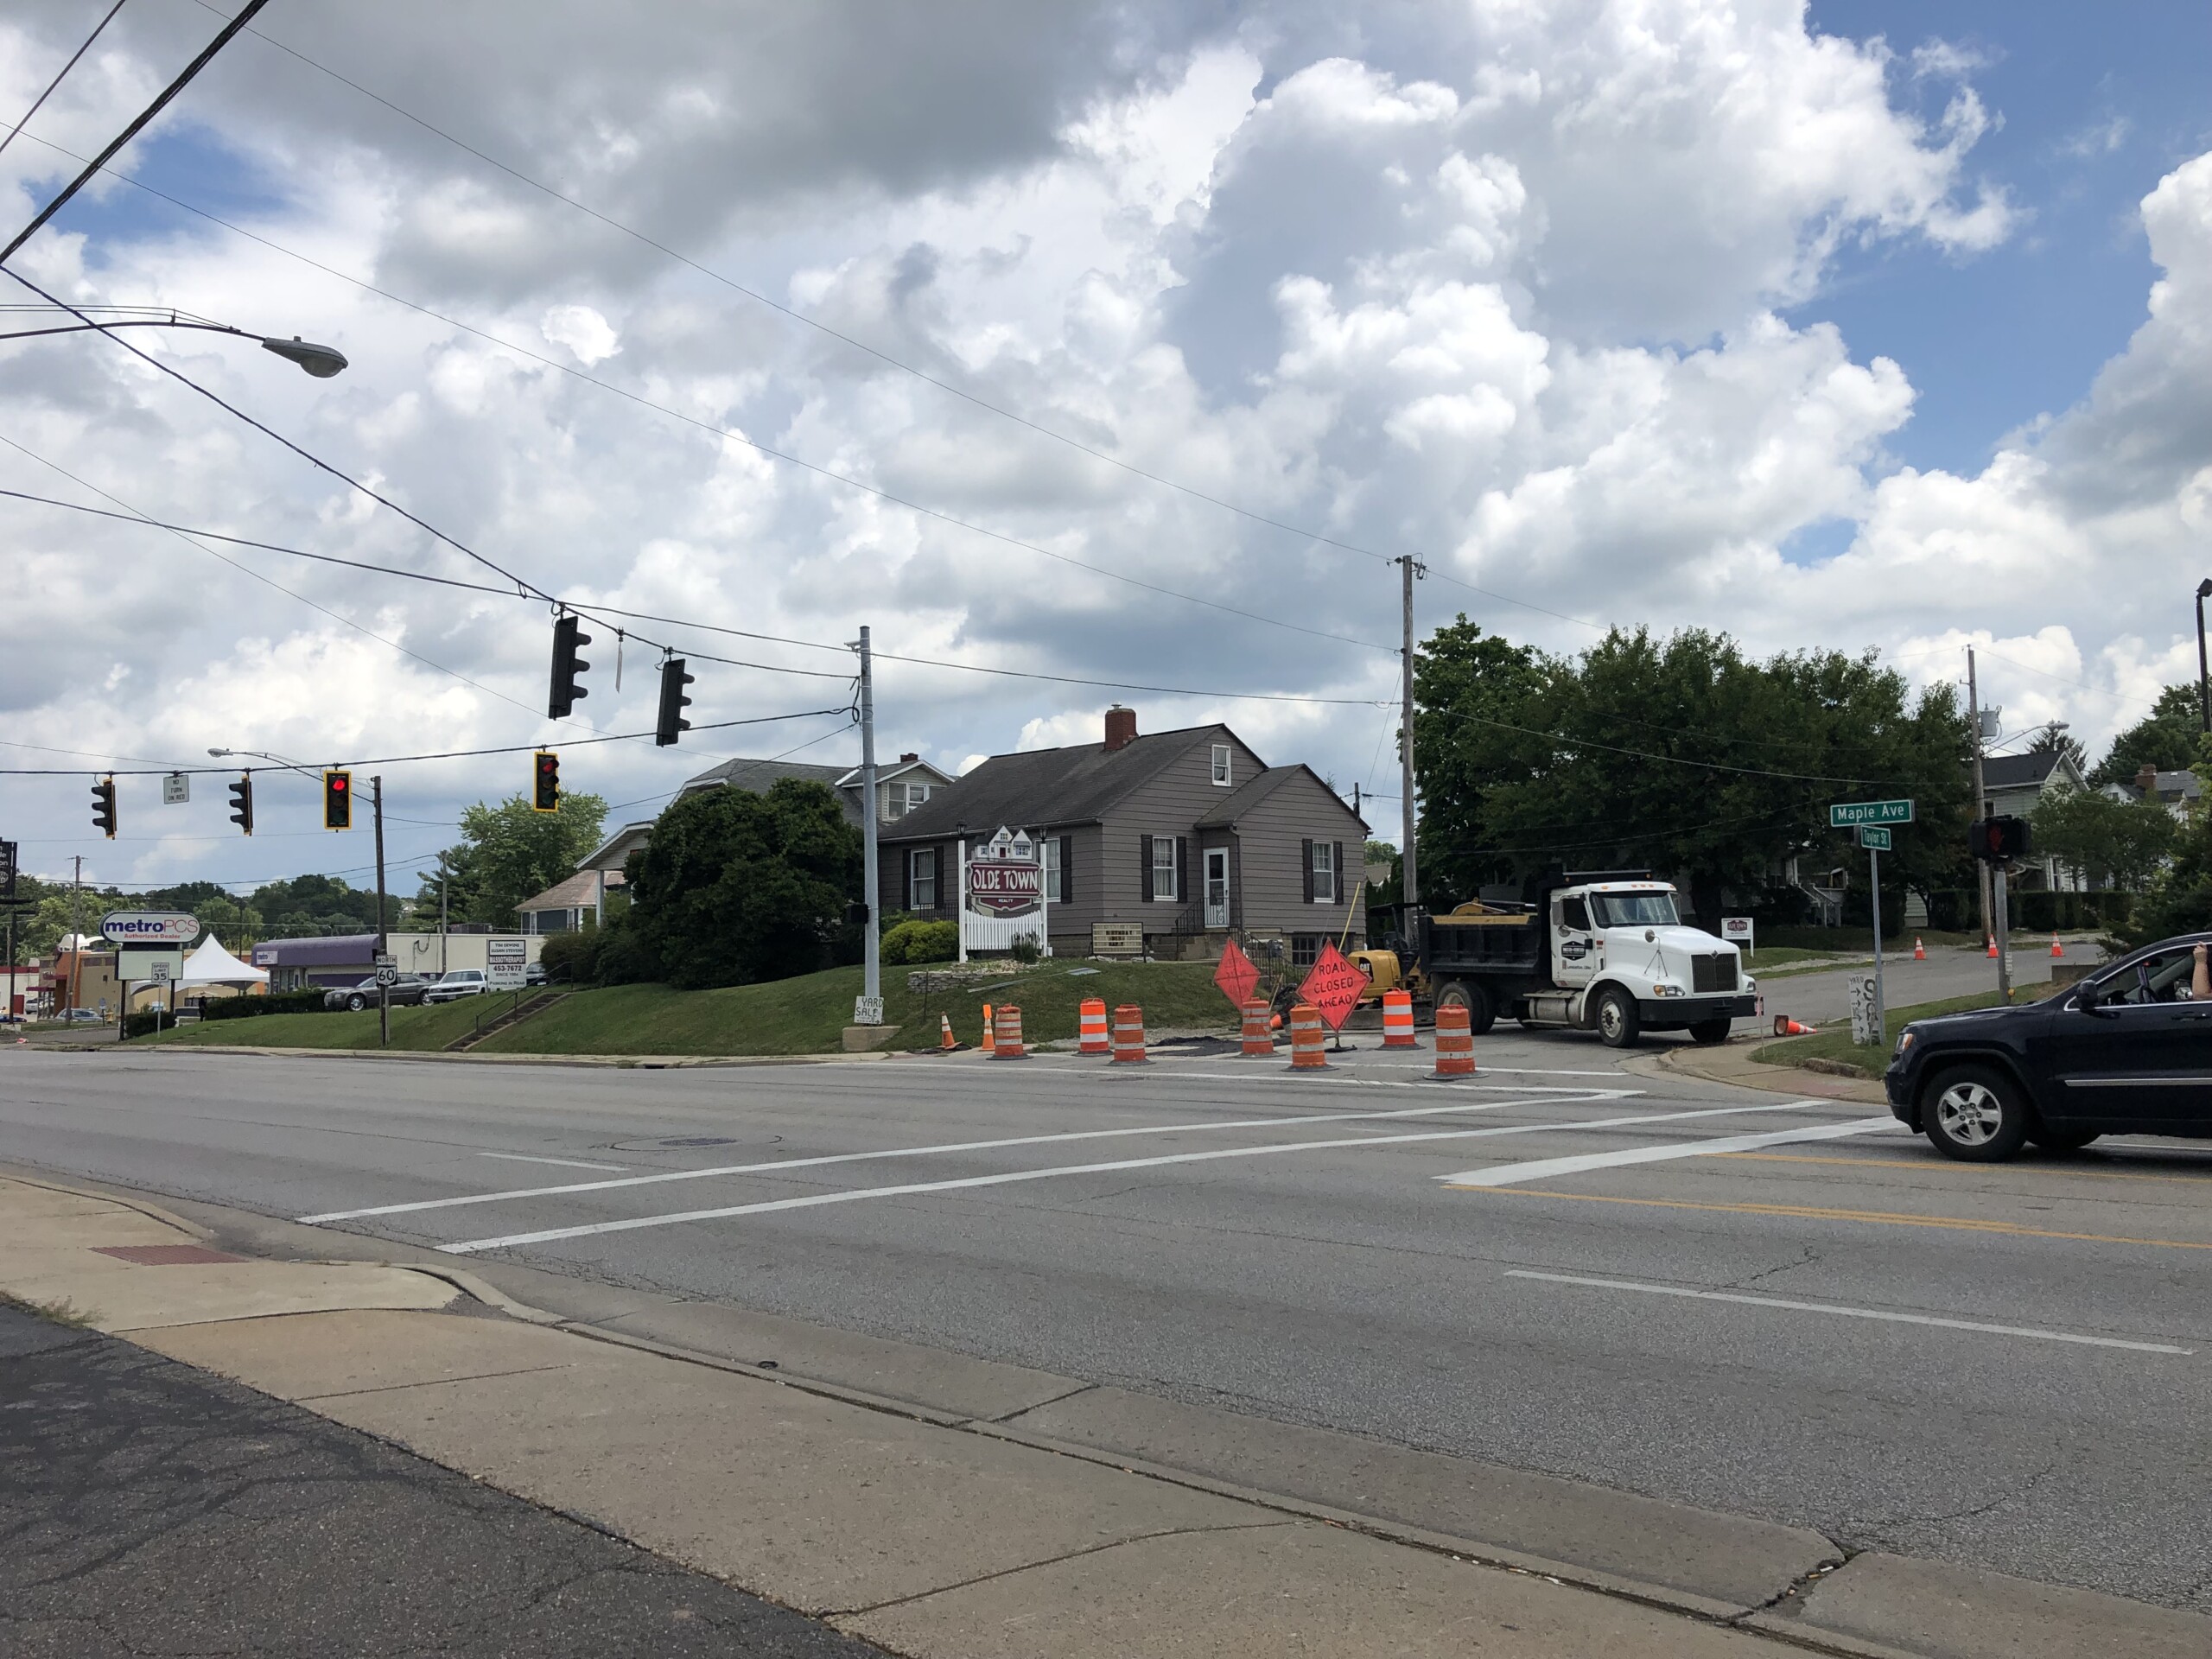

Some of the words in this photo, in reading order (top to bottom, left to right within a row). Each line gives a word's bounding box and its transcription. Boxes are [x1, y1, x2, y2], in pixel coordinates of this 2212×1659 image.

[1838, 806, 1875, 823] Maple
[1882, 804, 1904, 817] Ave
[1864, 830, 1879, 846] Taylor
[1881, 832, 1887, 844] St
[973, 869, 1001, 890] OLDE
[1003, 870, 1038, 890] TOWN
[105, 919, 198, 933] metroPCS
[378, 969, 394, 981] 60
[1319, 962, 1346, 976] ROAD
[1314, 977, 1353, 994] CLOSED
[861, 997, 884, 1007] YARD
[1318, 995, 1352, 1009] AHEAD
[855, 1007, 879, 1017] SALE
